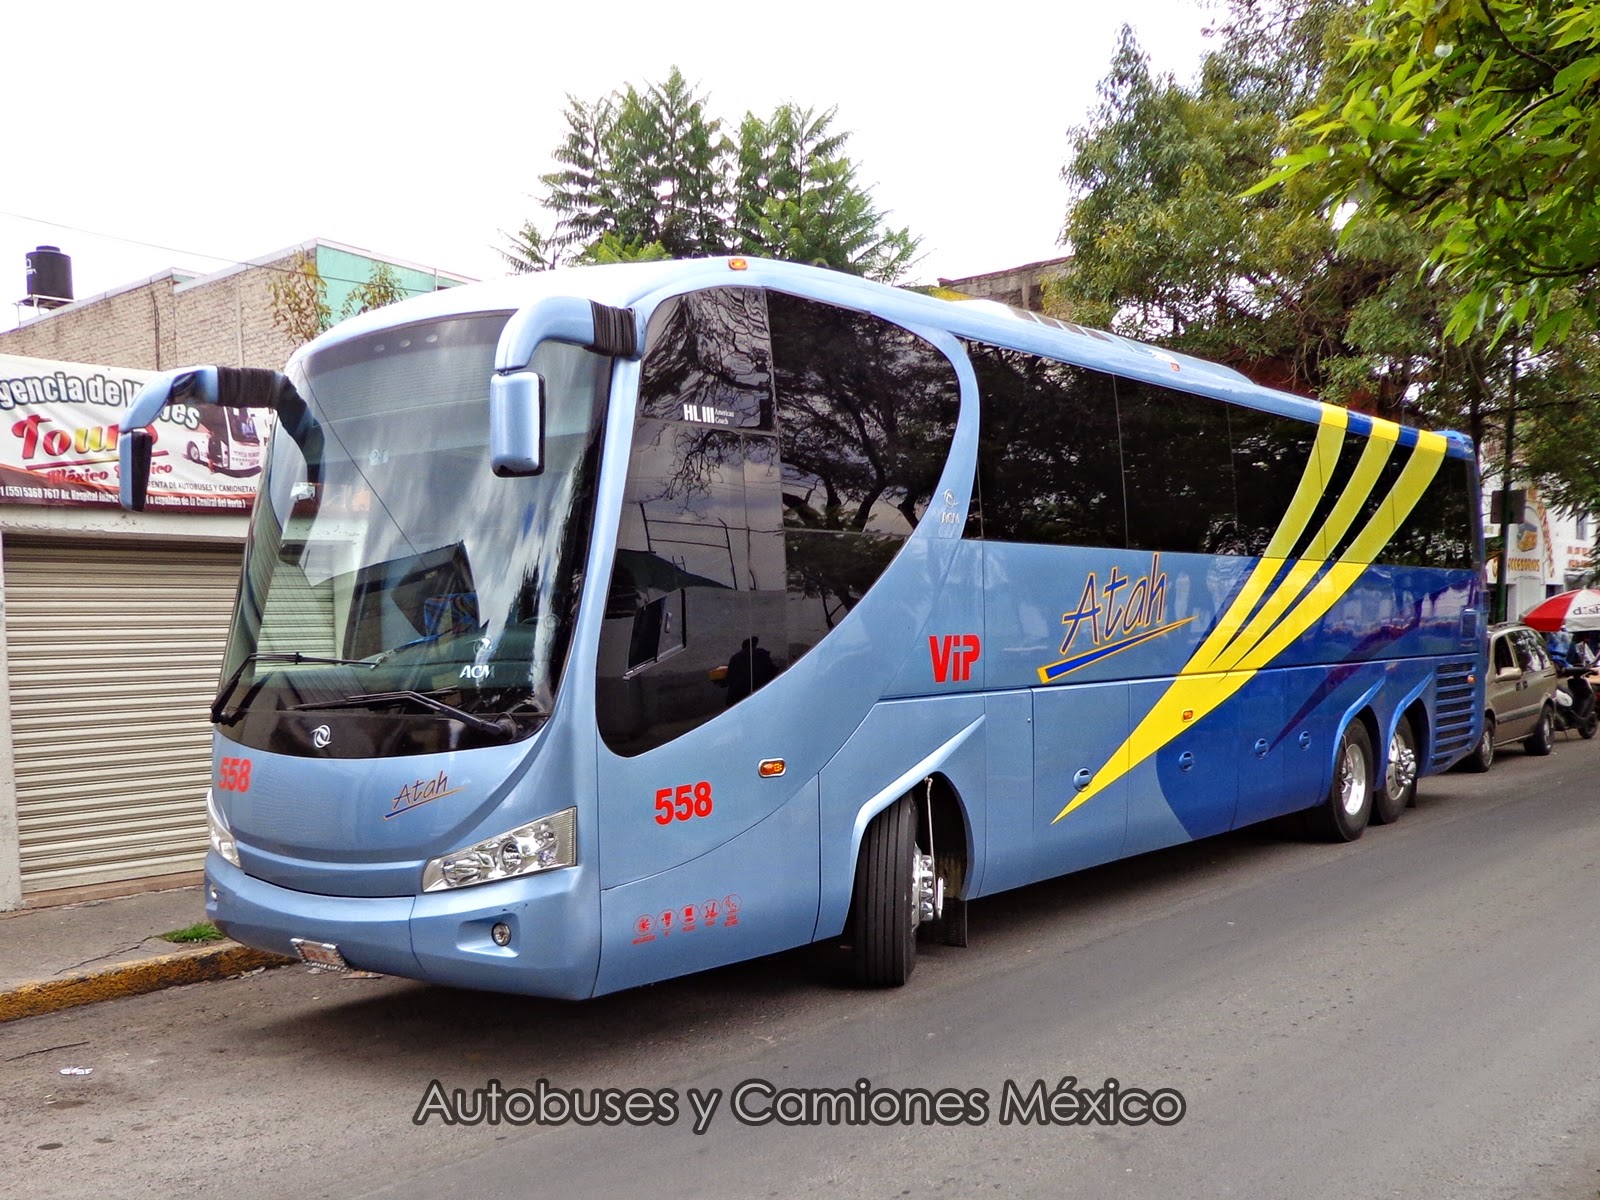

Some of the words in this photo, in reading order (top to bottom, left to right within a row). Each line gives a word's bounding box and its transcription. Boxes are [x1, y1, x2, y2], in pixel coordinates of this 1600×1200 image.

[87, 374, 121, 406] de
[169, 481, 177, 489] DE
[178, 482, 212, 491] AUTOBUSES
[1060, 552, 1167, 655] Atah
[459, 665, 495, 678] ACM
[218, 757, 252, 793] 558
[391, 770, 449, 810] Atah
[654, 781, 713, 826] 558
